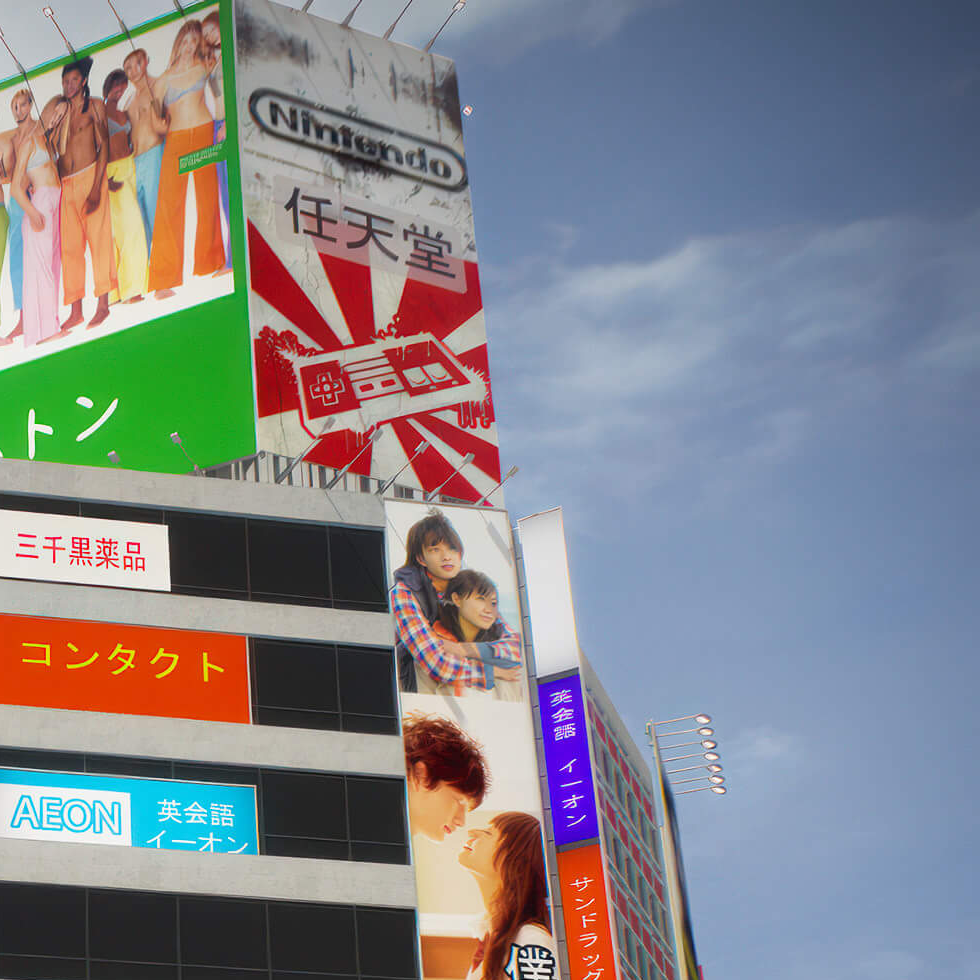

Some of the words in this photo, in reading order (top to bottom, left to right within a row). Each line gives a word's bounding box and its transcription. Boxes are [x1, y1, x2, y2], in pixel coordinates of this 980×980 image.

[269, 101, 453, 180] Nintendo
[283, 186, 456, 279] 任天堂
[15, 533, 147, 573] 三千黒薬品
[21, 641, 225, 683] コンタクト
[10, 794, 123, 836] AEON
[146, 830, 249, 854] イーオン
